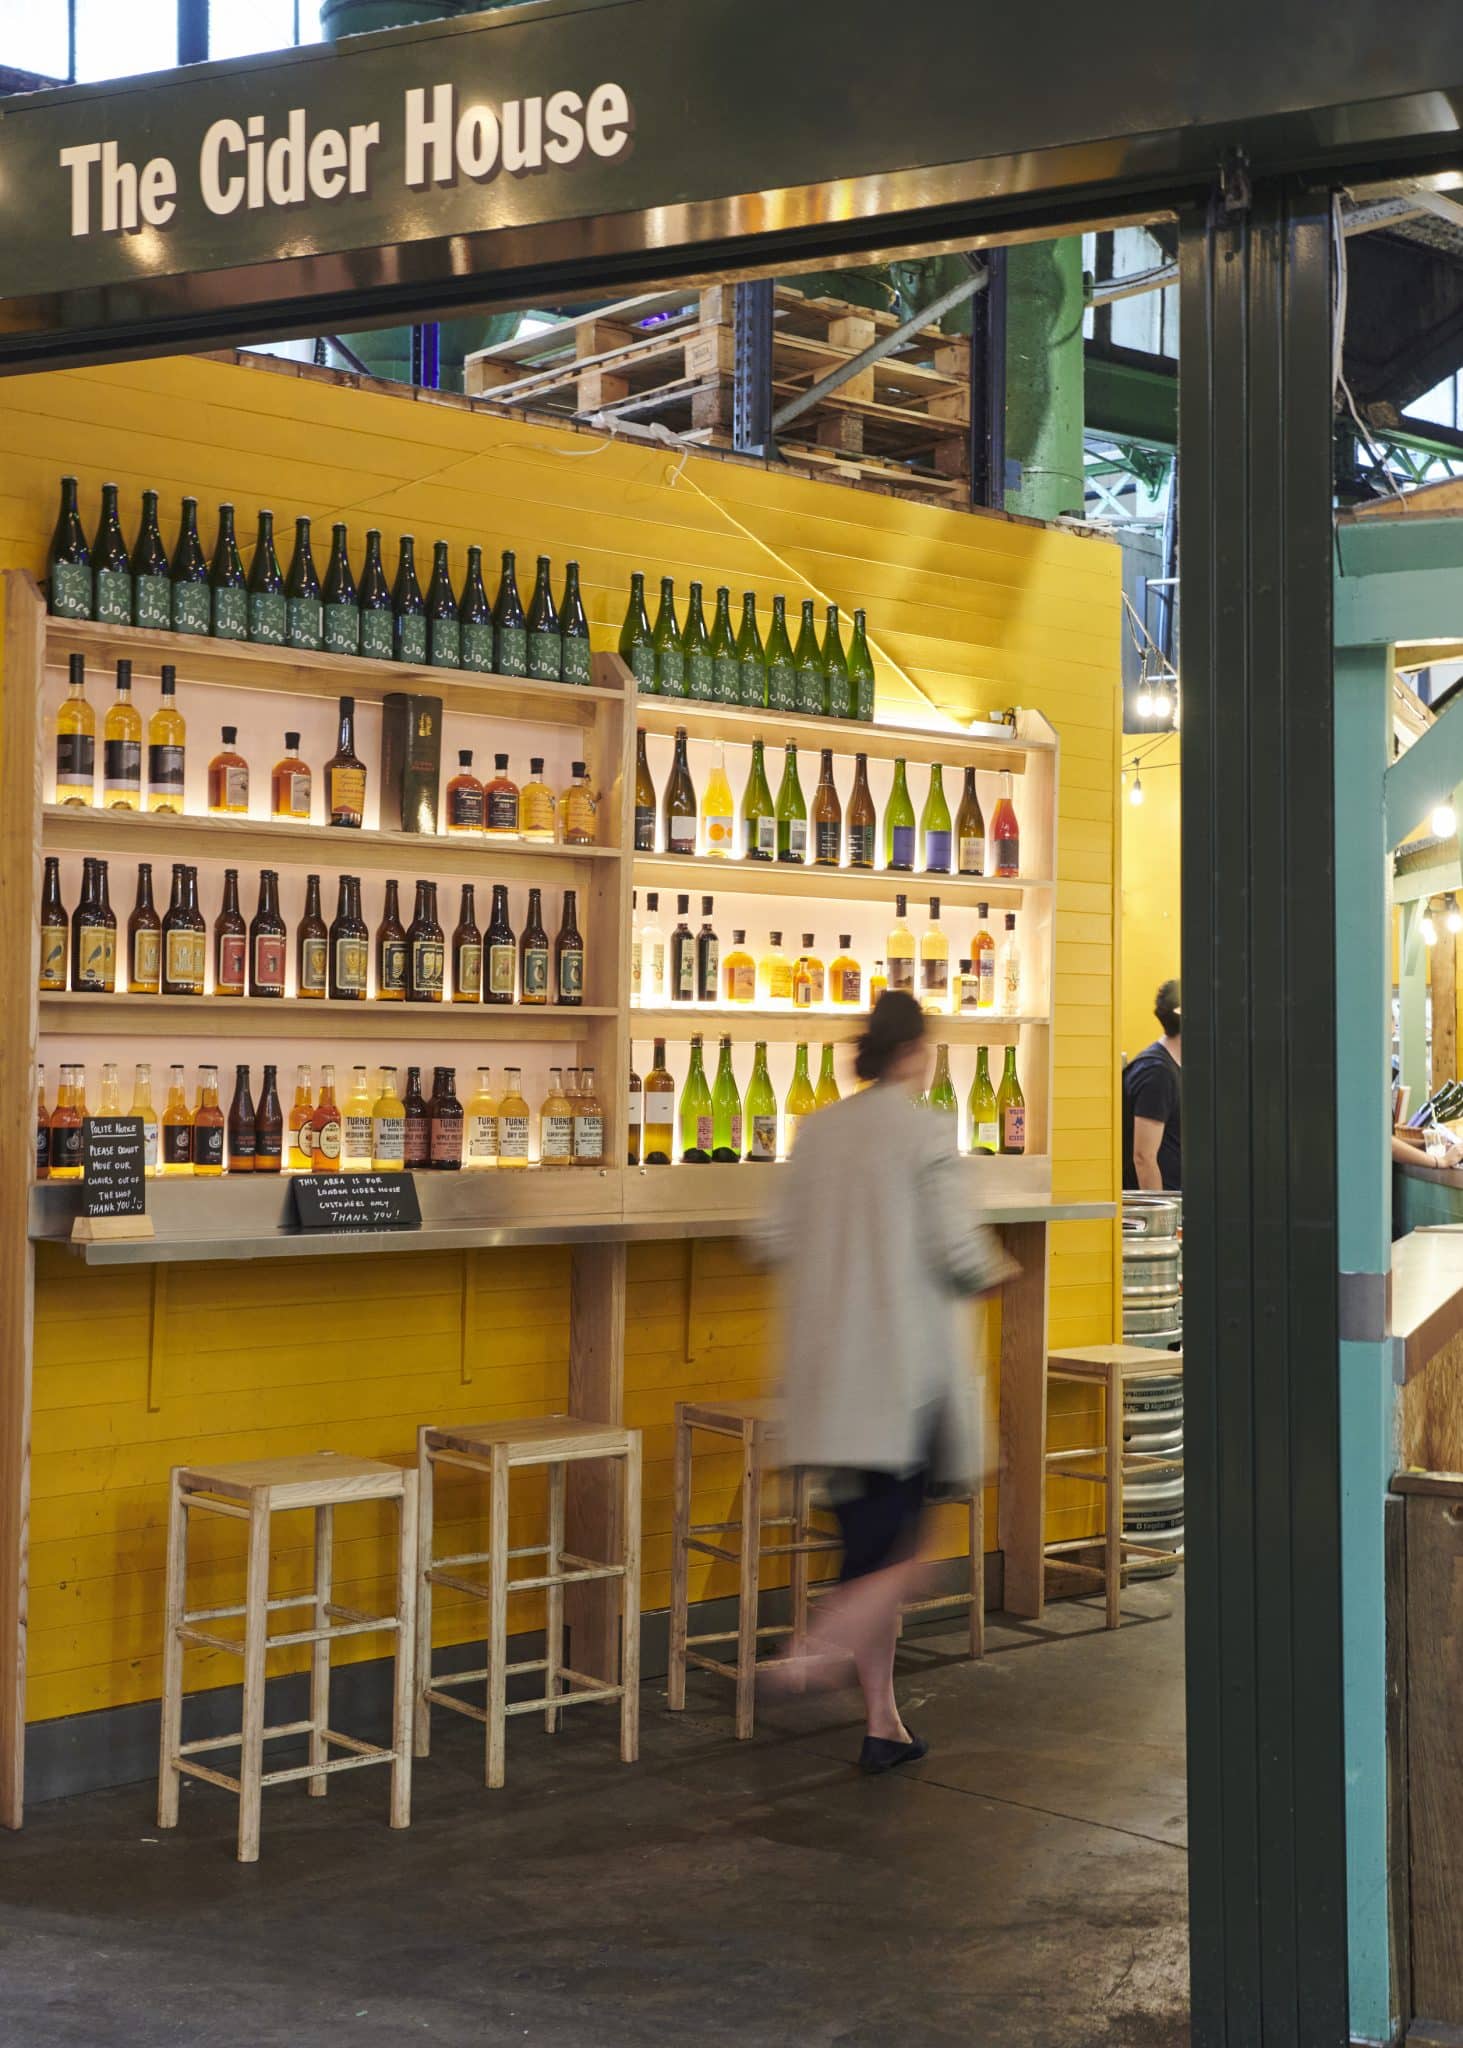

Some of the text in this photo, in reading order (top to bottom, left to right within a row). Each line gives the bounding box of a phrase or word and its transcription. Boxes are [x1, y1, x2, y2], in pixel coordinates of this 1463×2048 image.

[59, 82, 630, 236] The Cider House
[90, 1120, 112, 1134] POLITE
[89, 1144, 114, 1156] PLEASE
[93, 1161, 132, 1170] MOVE OUR
[88, 1177, 113, 1185] CHAIRS
[299, 1178, 318, 1186] THIS
[323, 1178, 345, 1186] AREA
[99, 1190, 131, 1200] THE SHOP
[317, 1188, 348, 1196] LONDON
[89, 1203, 115, 1215] THANK
[319, 1200, 389, 1209] CUSTOMERS ONLY
[331, 1212, 368, 1222] THANK
